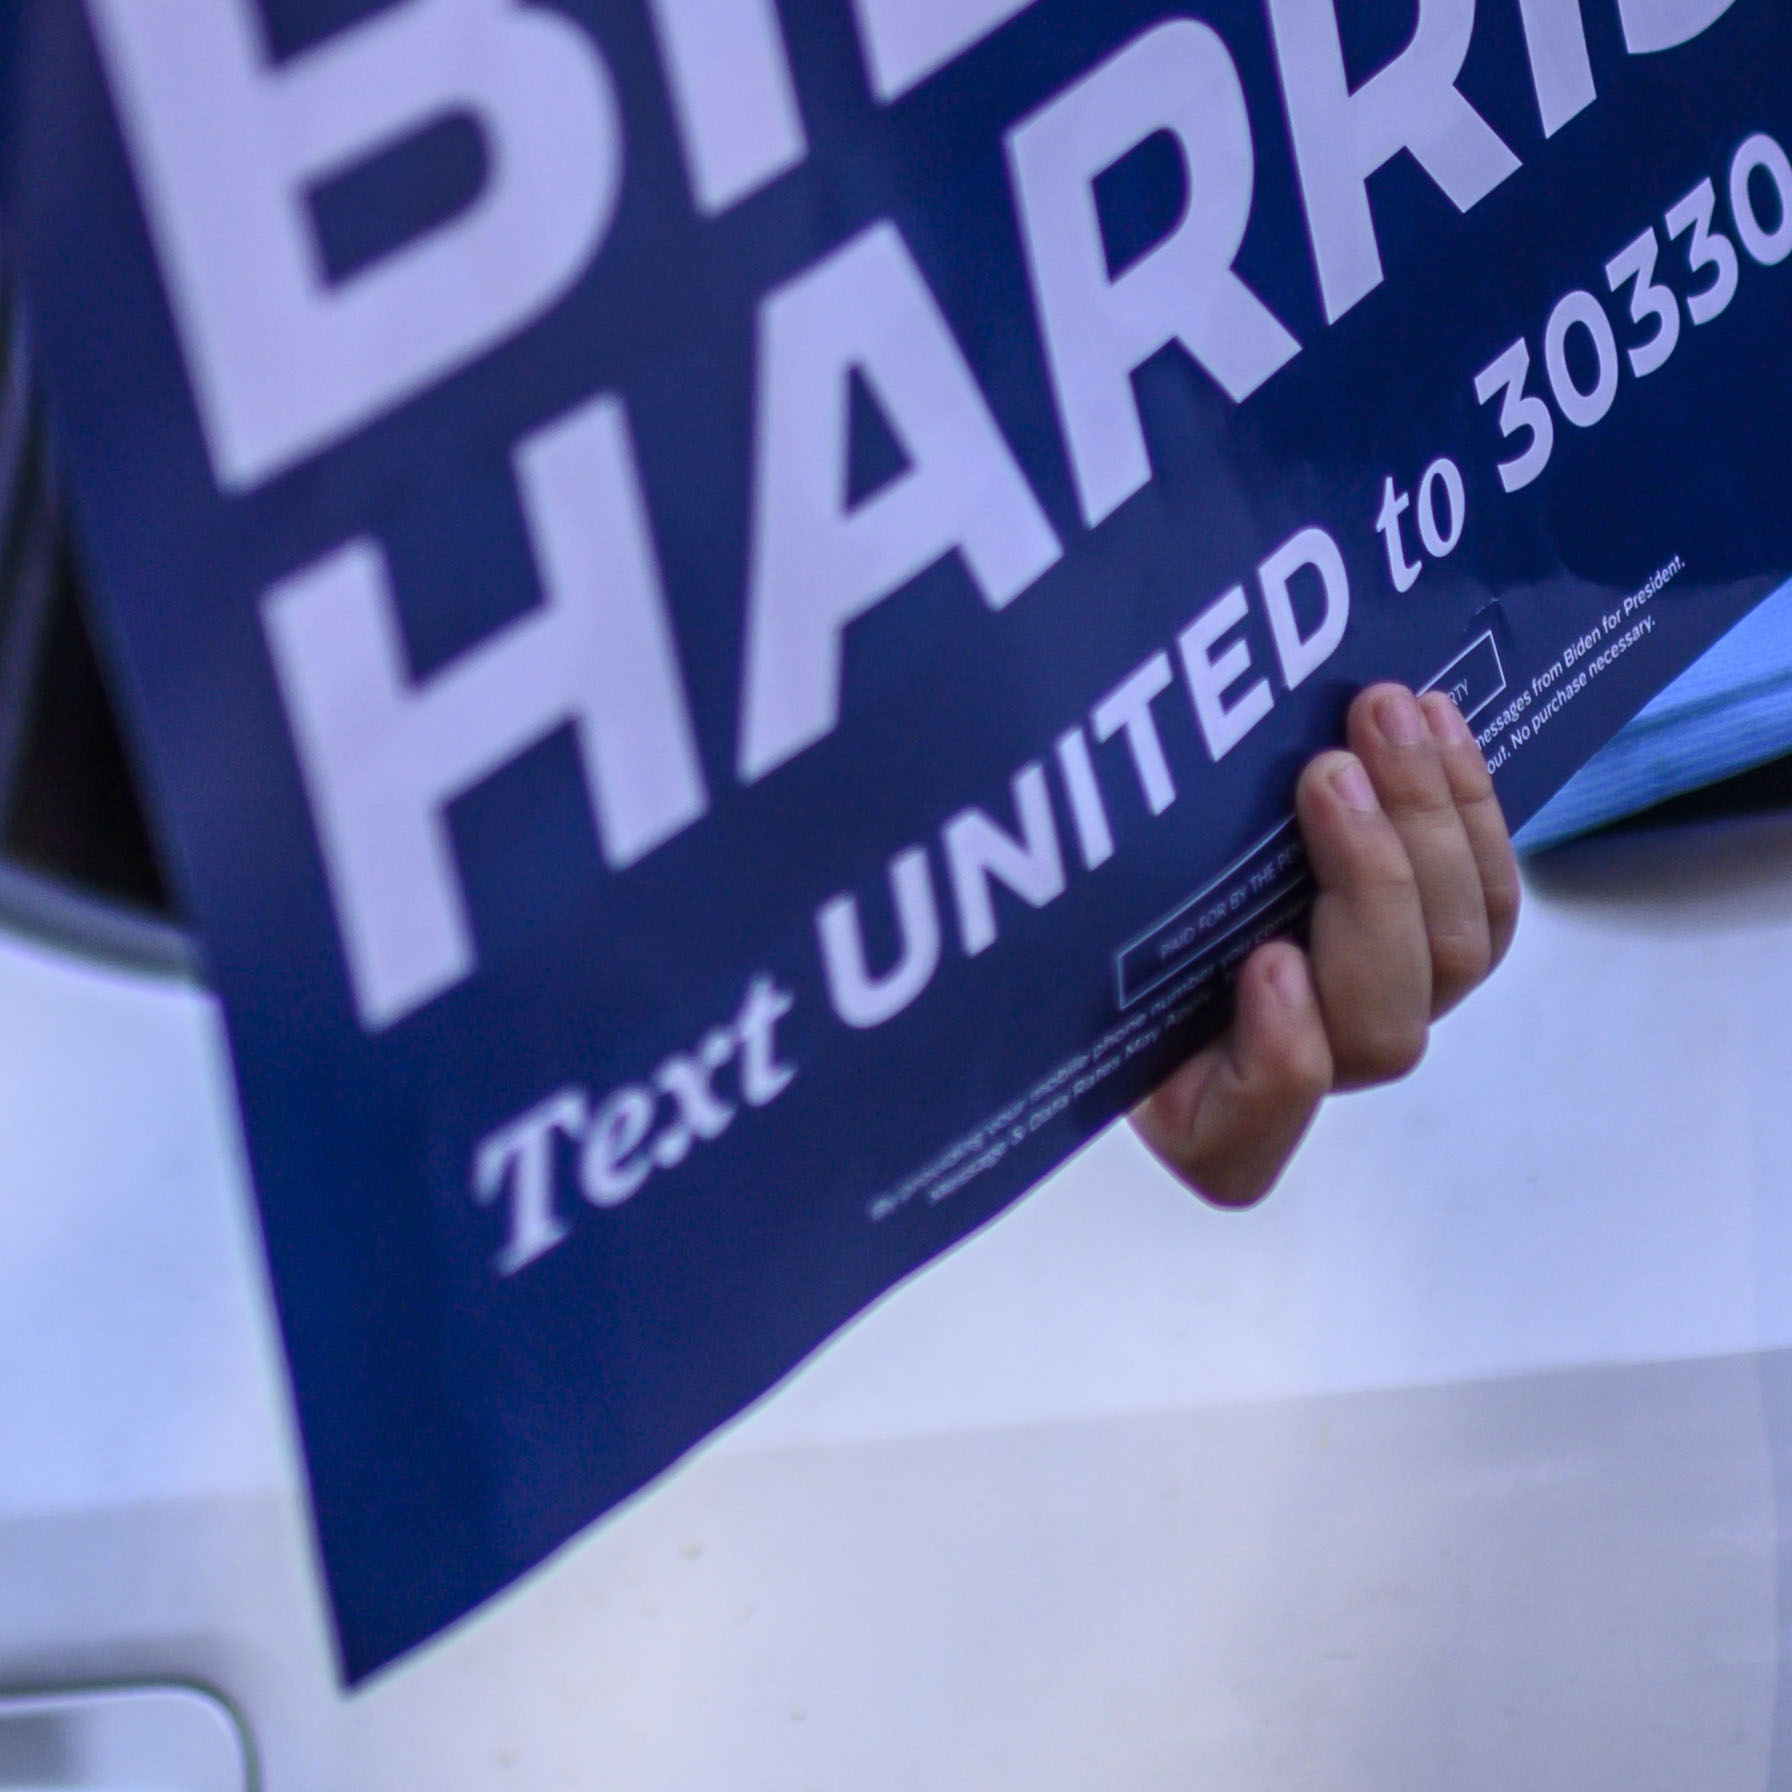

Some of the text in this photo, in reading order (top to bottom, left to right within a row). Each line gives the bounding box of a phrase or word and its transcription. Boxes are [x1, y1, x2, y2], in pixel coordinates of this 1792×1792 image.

[1510, 724, 1532, 751] No
[1531, 671, 1587, 736] purchase
[1588, 614, 1657, 680] necessary.
[1531, 659, 1564, 698] from
[1563, 625, 1602, 669] Biden
[1602, 611, 1623, 636] for
[1622, 553, 1687, 618] President.
[472, 972, 798, 1276] Text
[816, 522, 1352, 1030] UNITED
[1374, 455, 1466, 595] to
[1197, 901, 1227, 934] FOR
[1229, 885, 1248, 911] BY
[1249, 861, 1276, 894] THE
